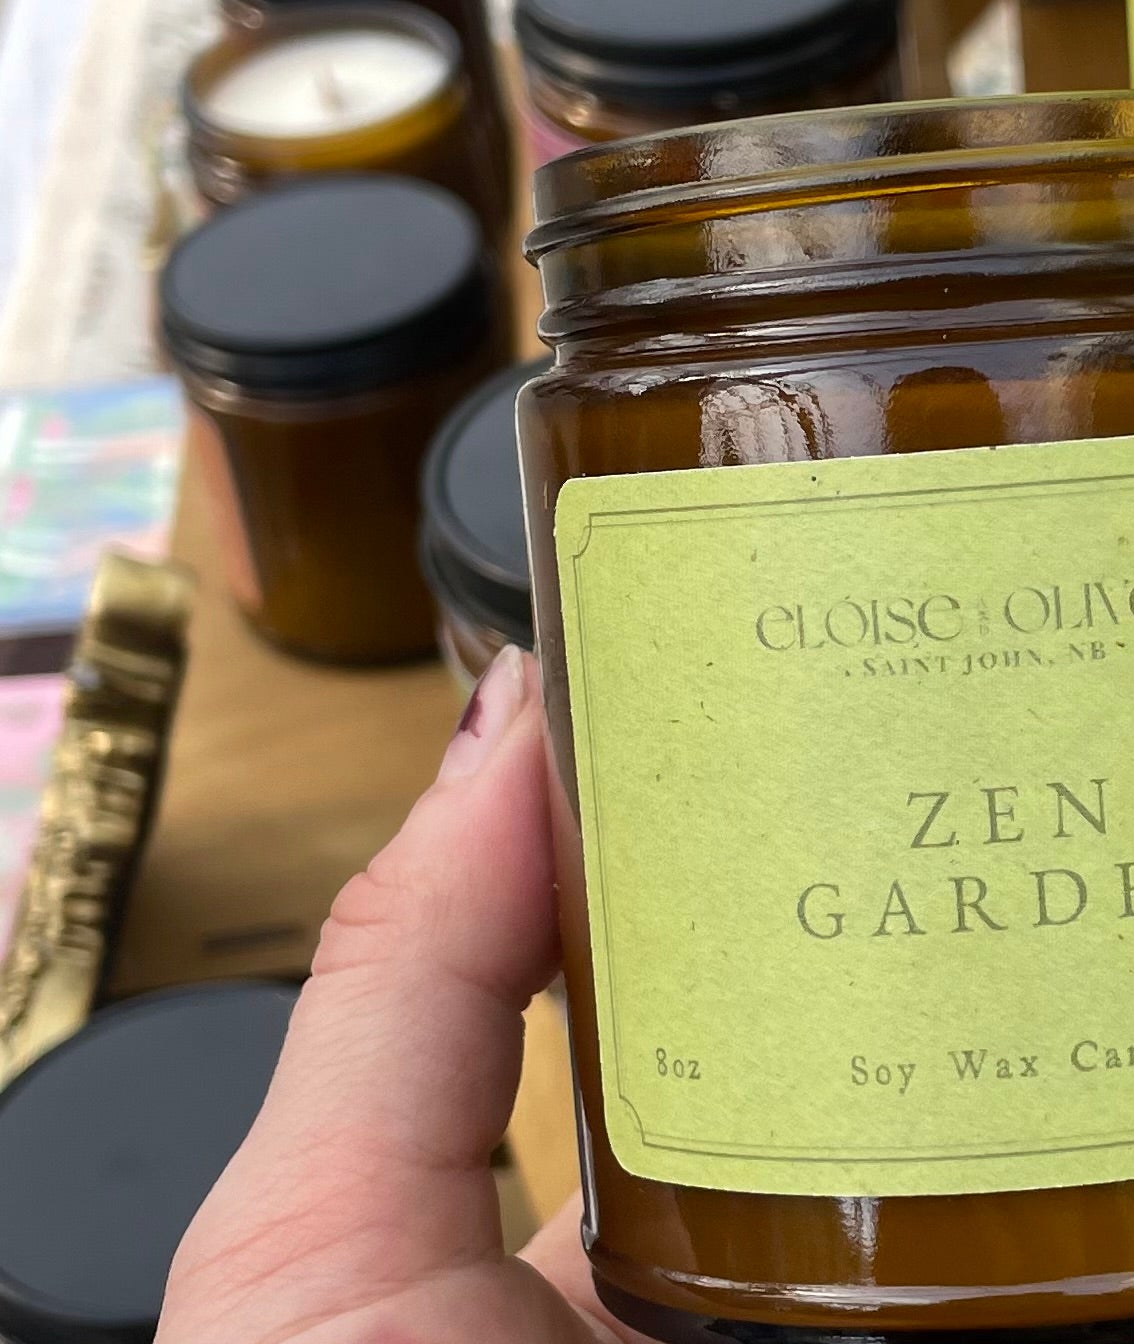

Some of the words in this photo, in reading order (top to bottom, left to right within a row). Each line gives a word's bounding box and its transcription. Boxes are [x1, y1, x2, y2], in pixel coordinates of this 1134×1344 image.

[863, 655, 948, 677] SAINT
[1068, 640, 1107, 662] NB
[906, 777, 1110, 850] ZEN
[656, 1047, 702, 1080] 8oz
[851, 1056, 916, 1094] Soy
[949, 1049, 1040, 1081] Wax
